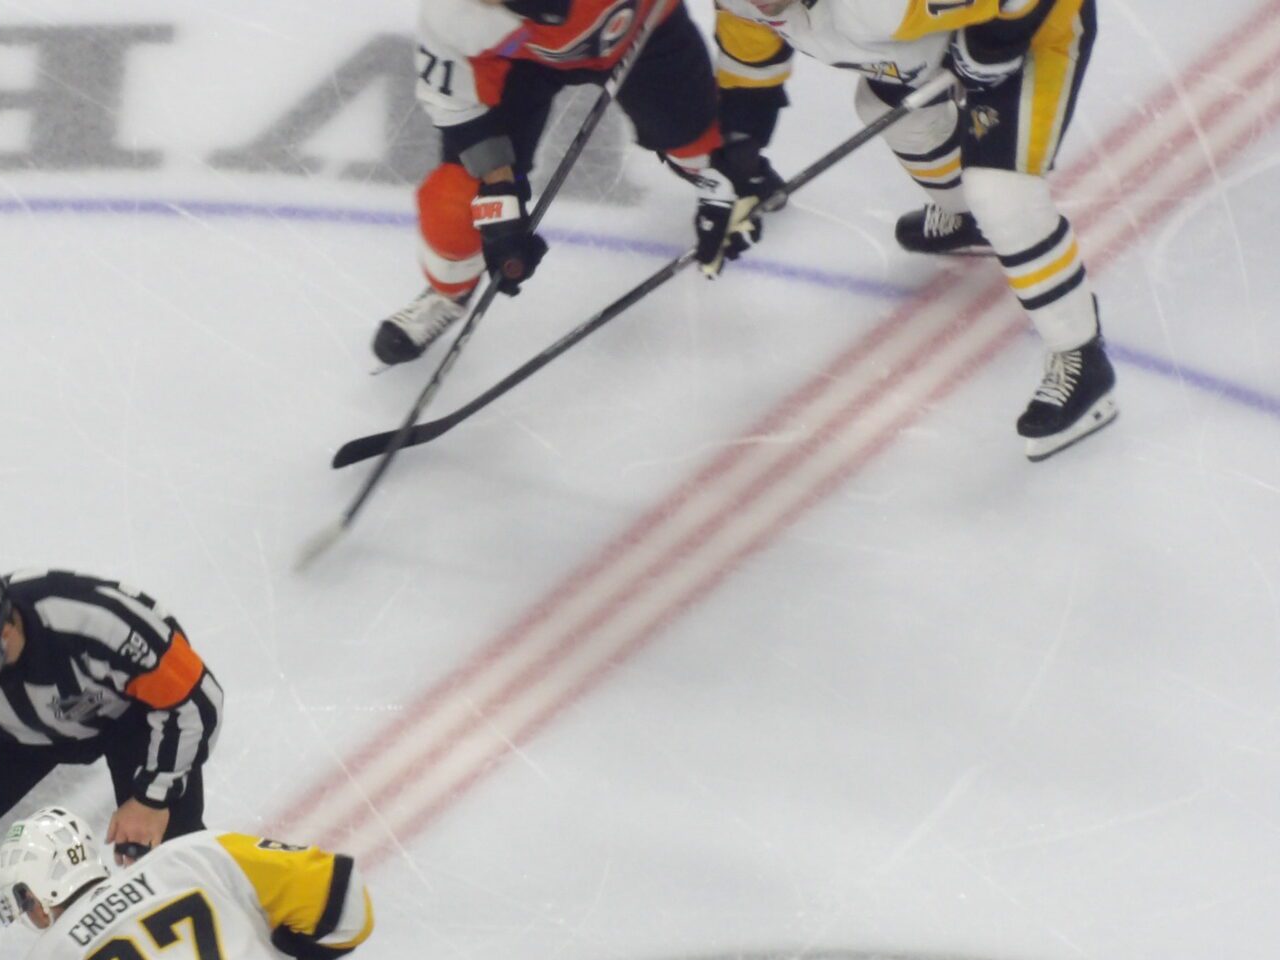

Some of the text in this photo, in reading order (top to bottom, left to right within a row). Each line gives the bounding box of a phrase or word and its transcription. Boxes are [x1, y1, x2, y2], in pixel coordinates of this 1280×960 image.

[417, 46, 455, 97] 71
[66, 843, 87, 866] 87
[68, 872, 157, 947] CROSBY
